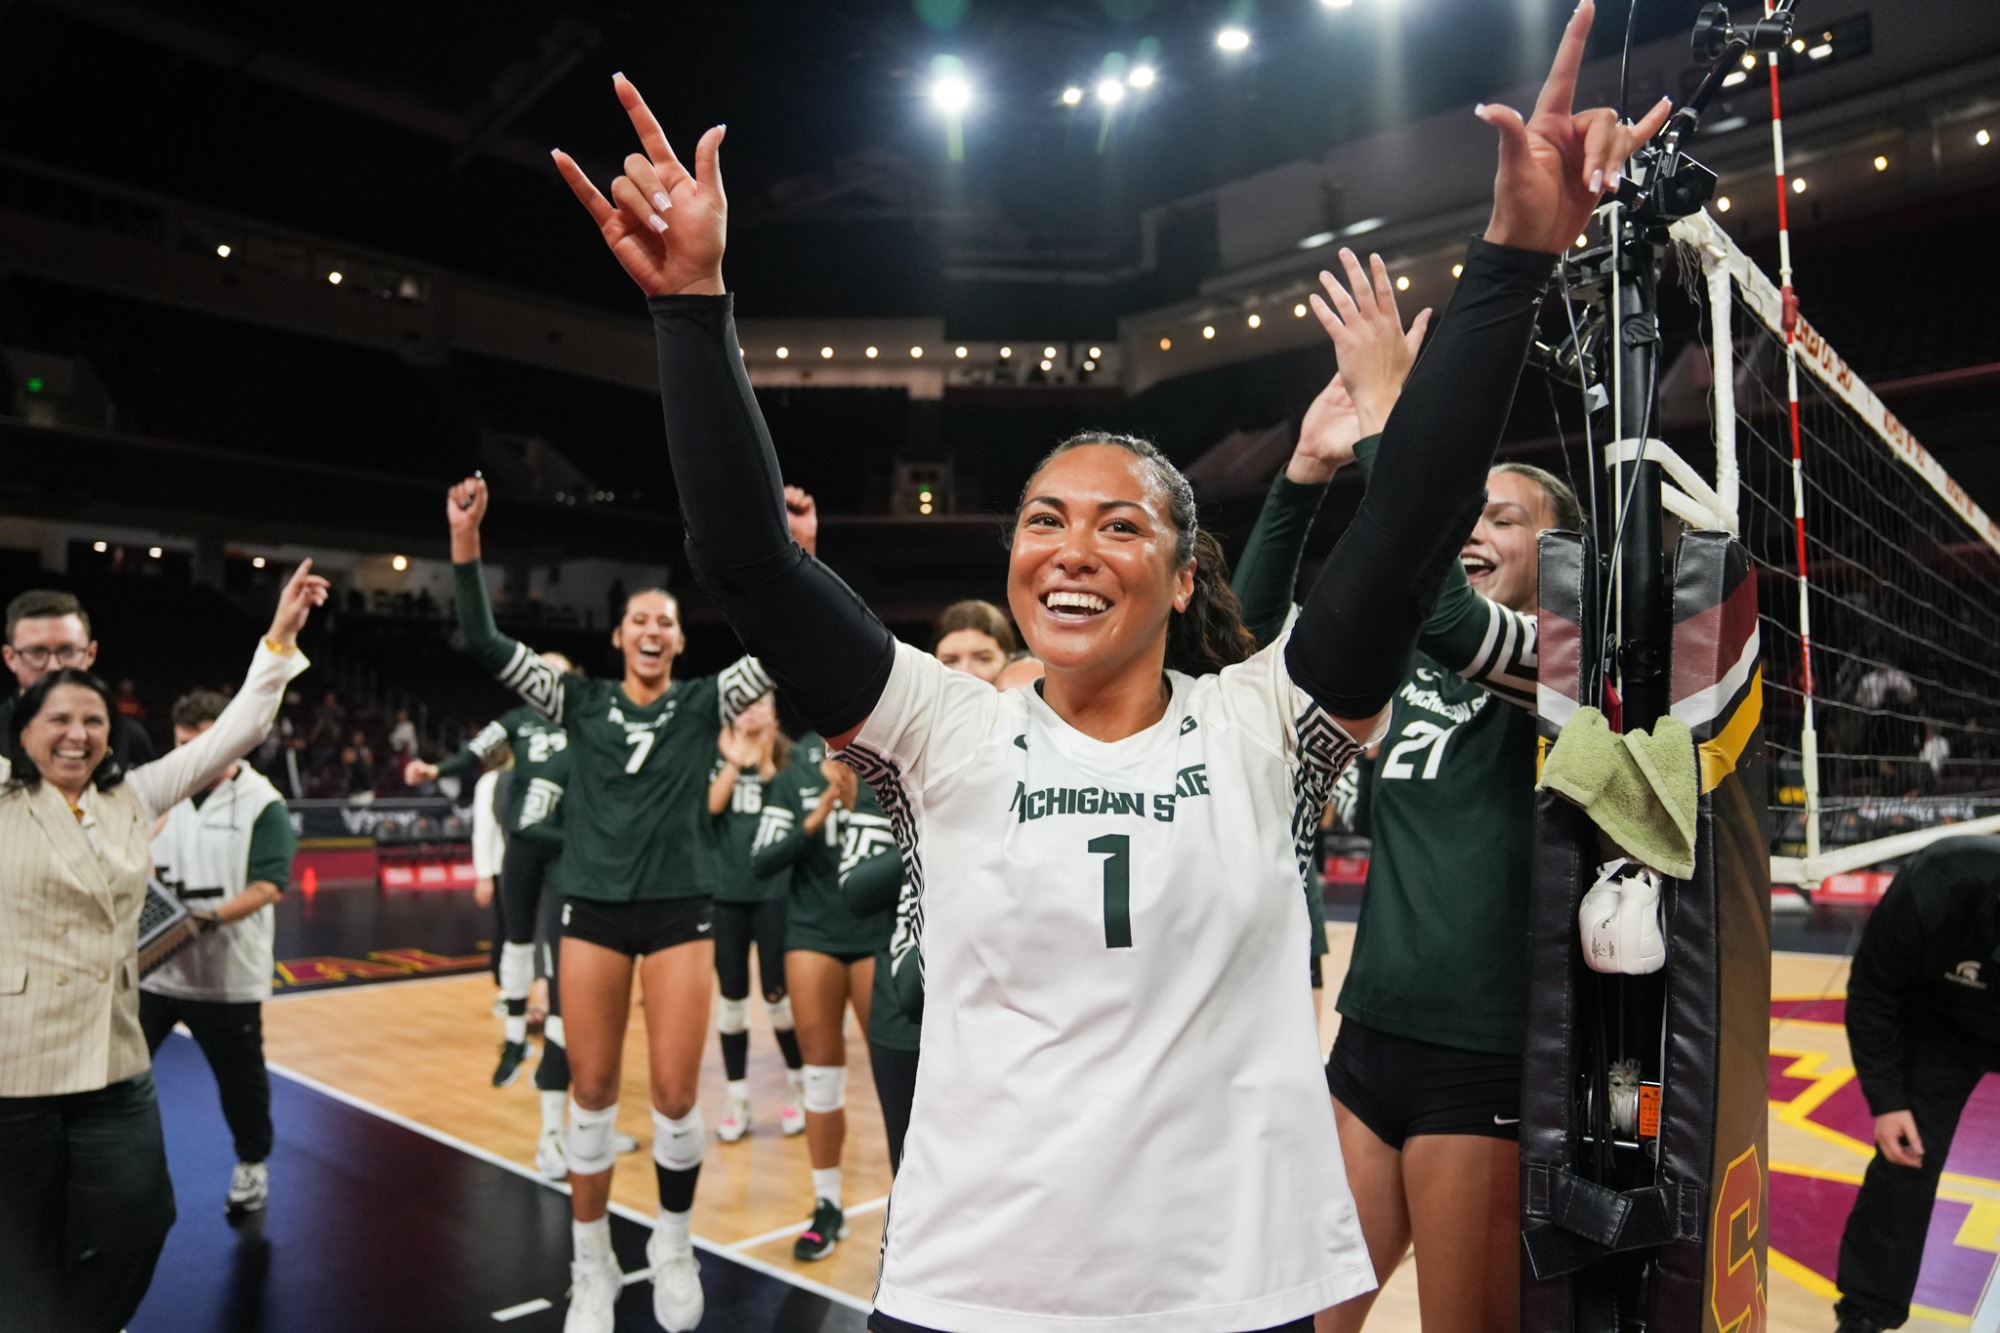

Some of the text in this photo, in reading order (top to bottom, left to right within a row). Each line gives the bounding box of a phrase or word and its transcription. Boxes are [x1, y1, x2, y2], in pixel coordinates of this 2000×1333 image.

[624, 730, 655, 774] 7
[1381, 719, 1459, 779] 21
[731, 782, 763, 815] 16
[1153, 763, 1211, 822] SATE
[1087, 833, 1133, 949] 1
